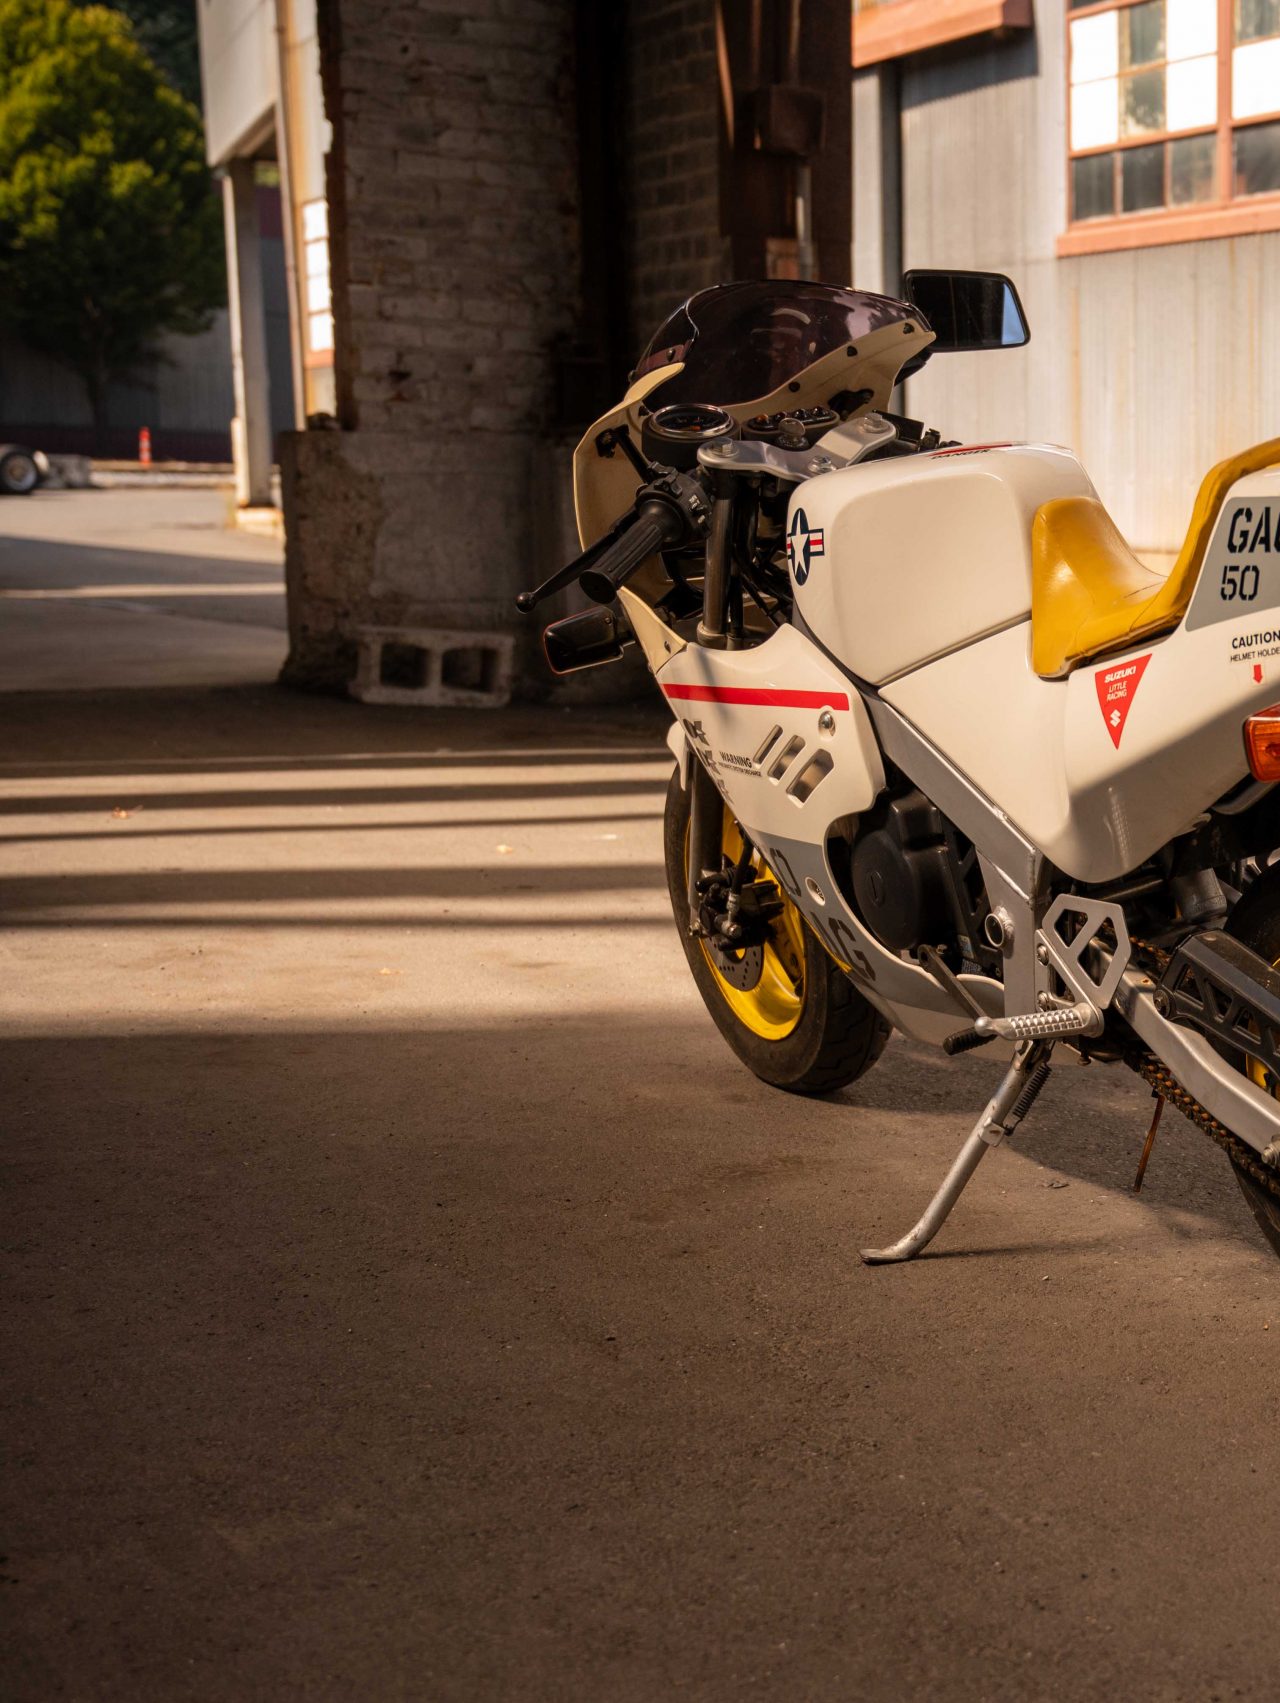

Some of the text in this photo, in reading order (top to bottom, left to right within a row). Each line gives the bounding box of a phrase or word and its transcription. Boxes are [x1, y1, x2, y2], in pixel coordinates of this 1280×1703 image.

[1220, 565, 1260, 601] 50
[1231, 630, 1280, 649] CAUTION
[1230, 651, 1256, 662] HELMET
[1104, 666, 1137, 683] SUZUKI
[1108, 680, 1128, 693] LITTLE
[1106, 689, 1128, 702] RACING
[719, 751, 752, 768] WARNING
